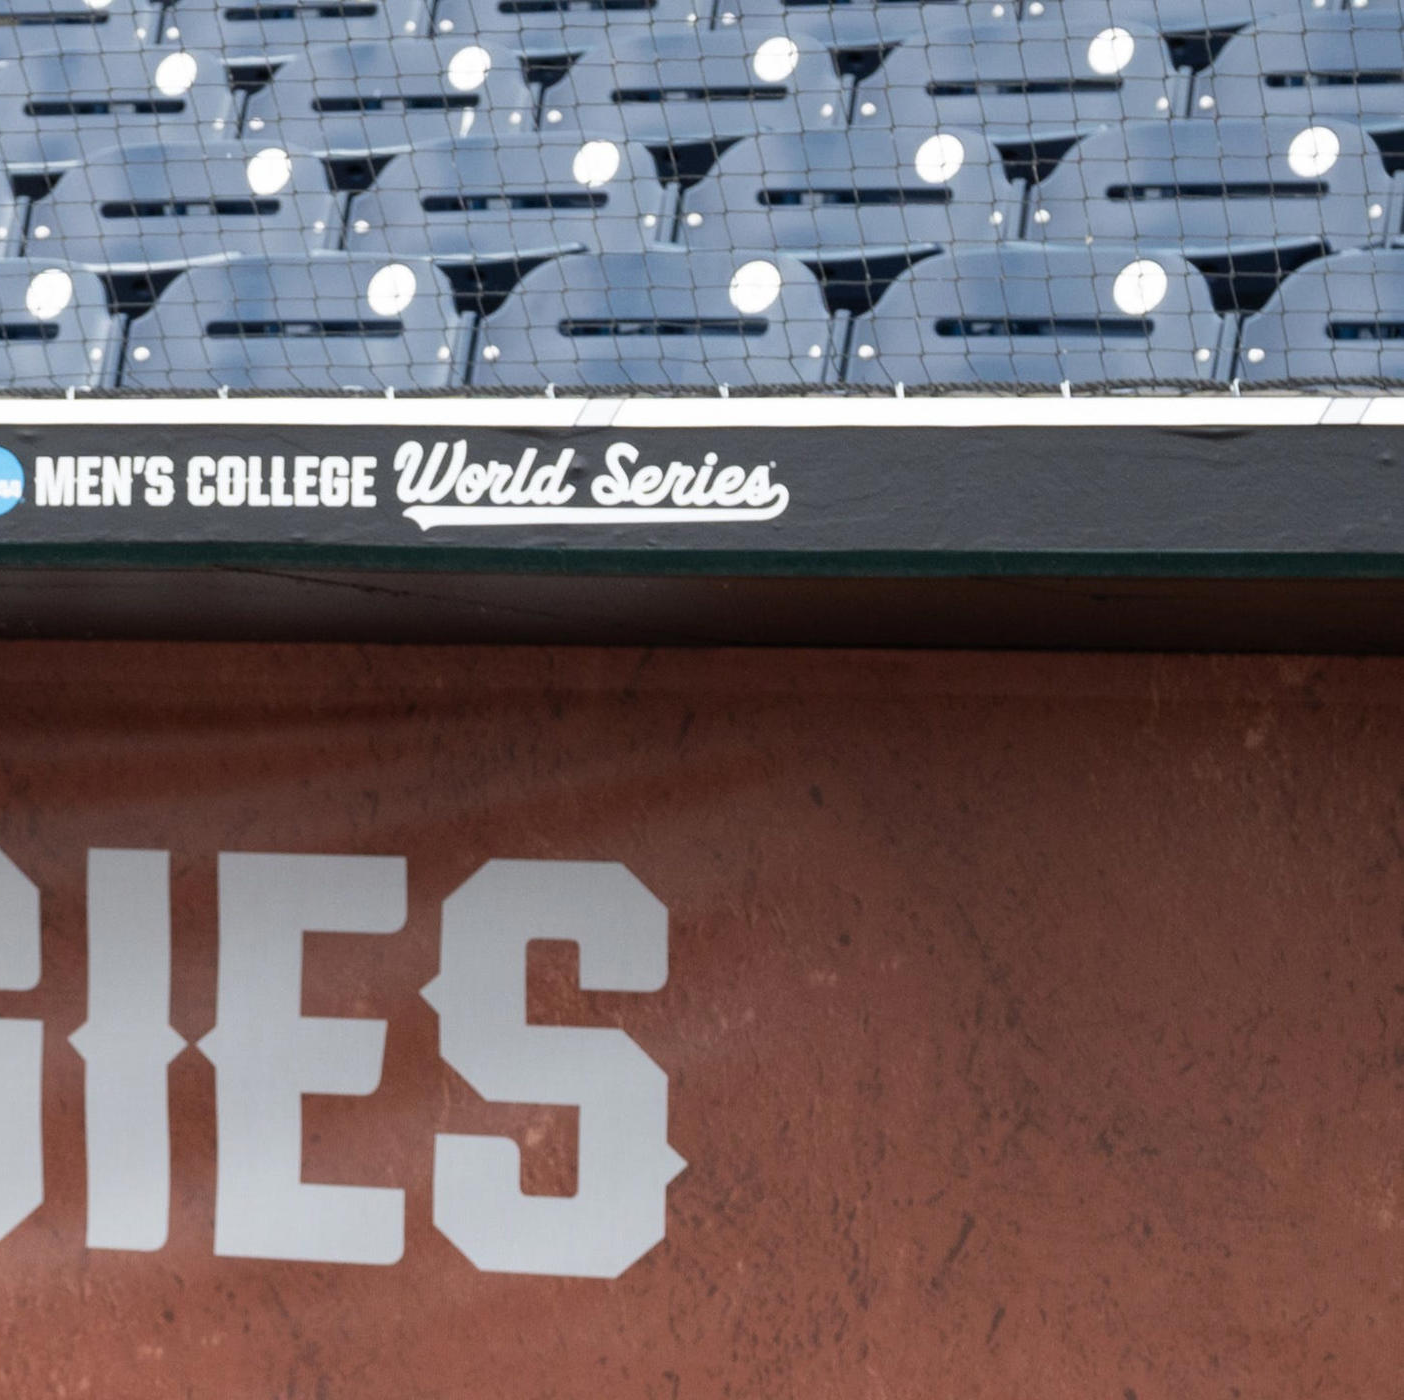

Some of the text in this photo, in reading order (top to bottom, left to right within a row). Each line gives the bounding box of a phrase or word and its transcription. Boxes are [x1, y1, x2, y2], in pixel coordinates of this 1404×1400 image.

[34, 439, 790, 510] MEN'S COLLEGE World Series
